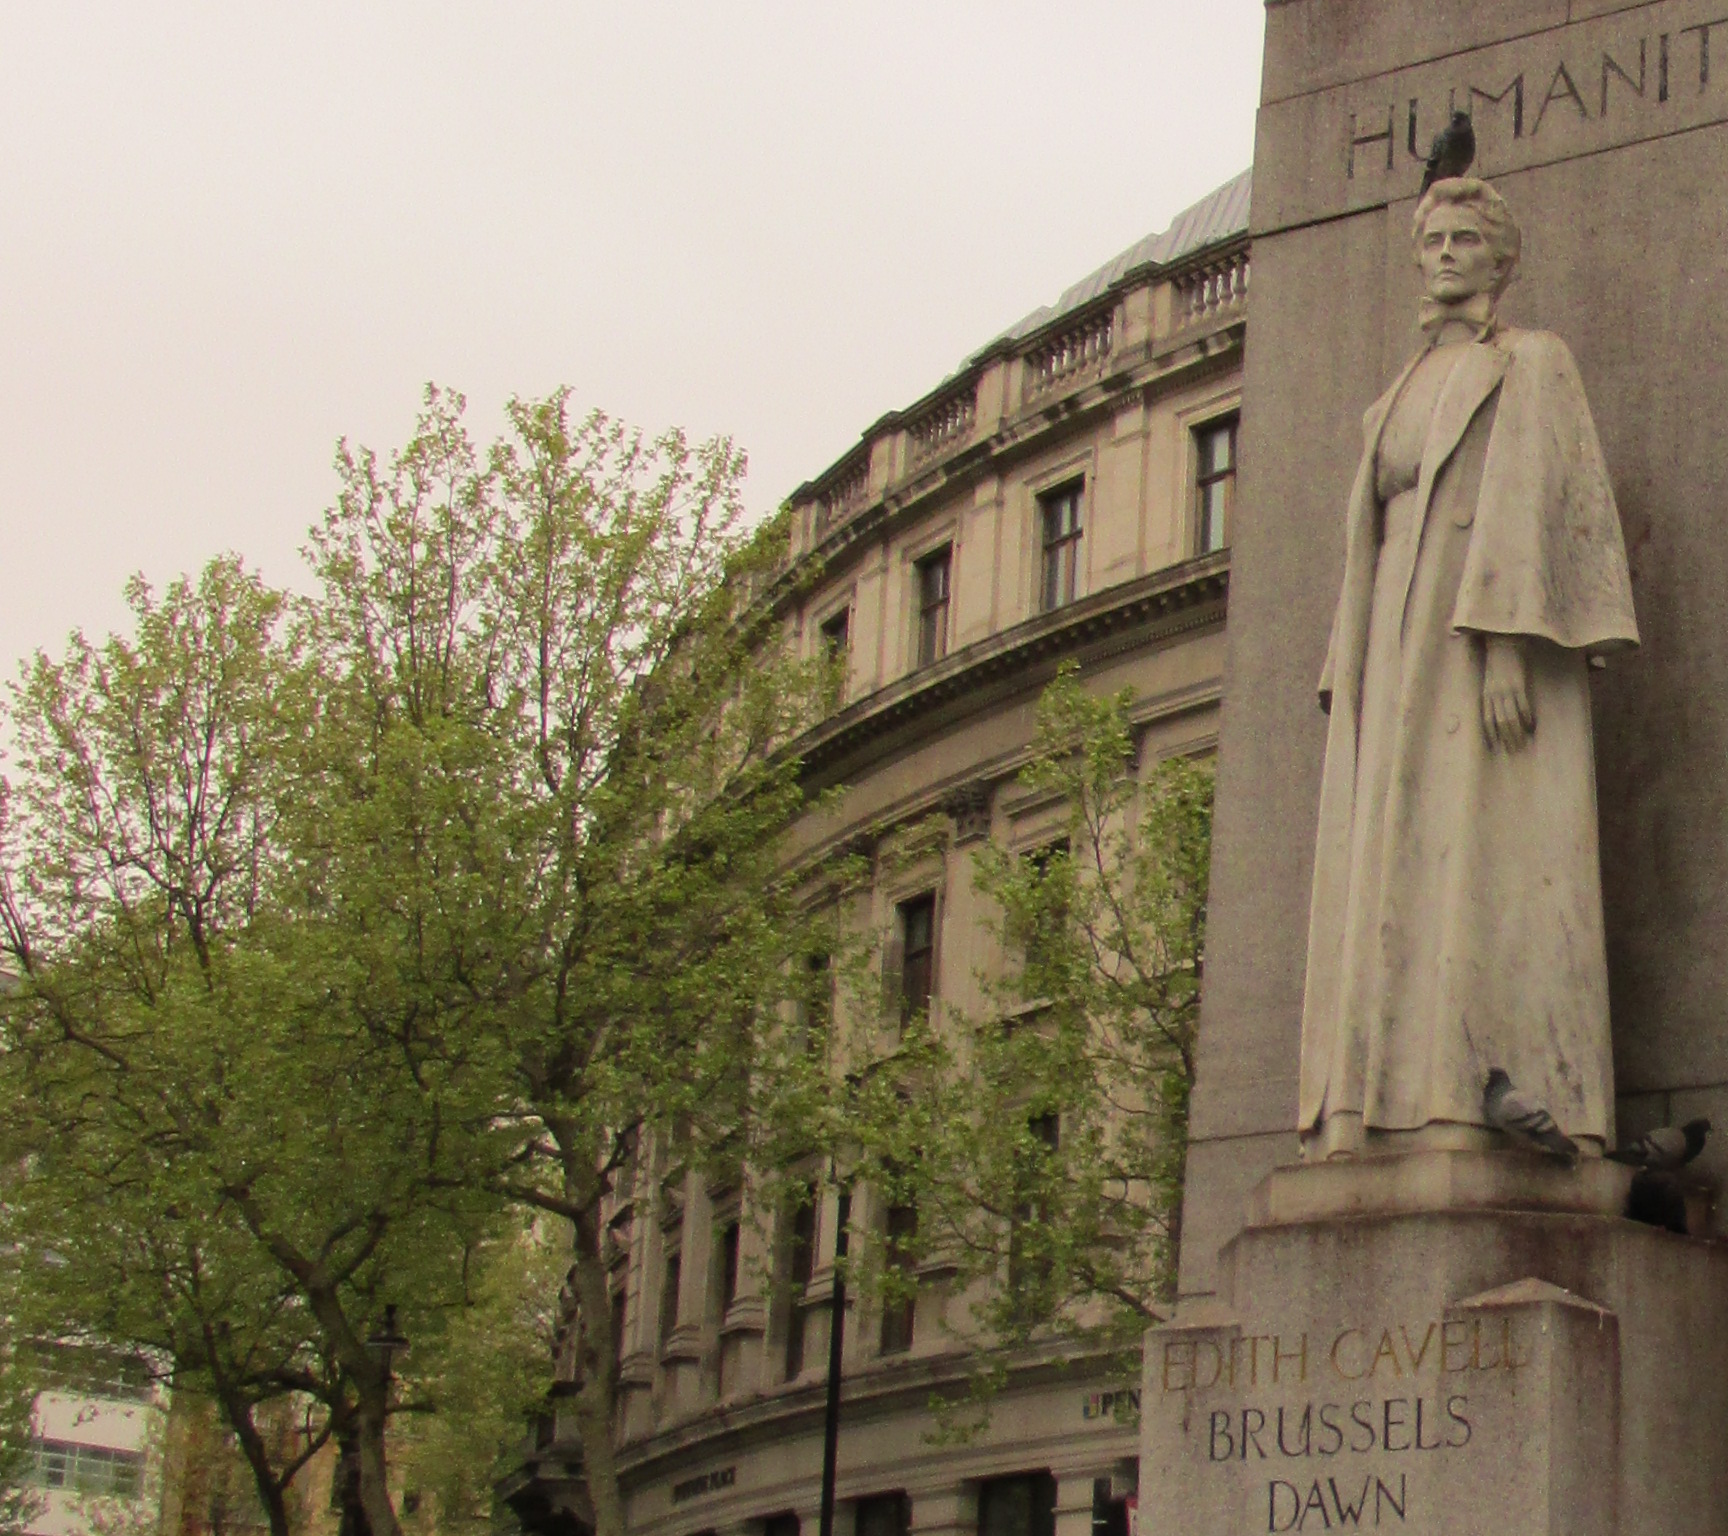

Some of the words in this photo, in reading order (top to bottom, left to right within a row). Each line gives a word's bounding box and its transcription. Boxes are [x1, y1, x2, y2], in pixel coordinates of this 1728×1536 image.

[1161, 1332, 1308, 1392] EDITH
[1331, 1316, 1531, 1381] CAVELL
[1209, 1394, 1473, 1462] BRUSSELS
[1268, 1473, 1407, 1533] DAWN
